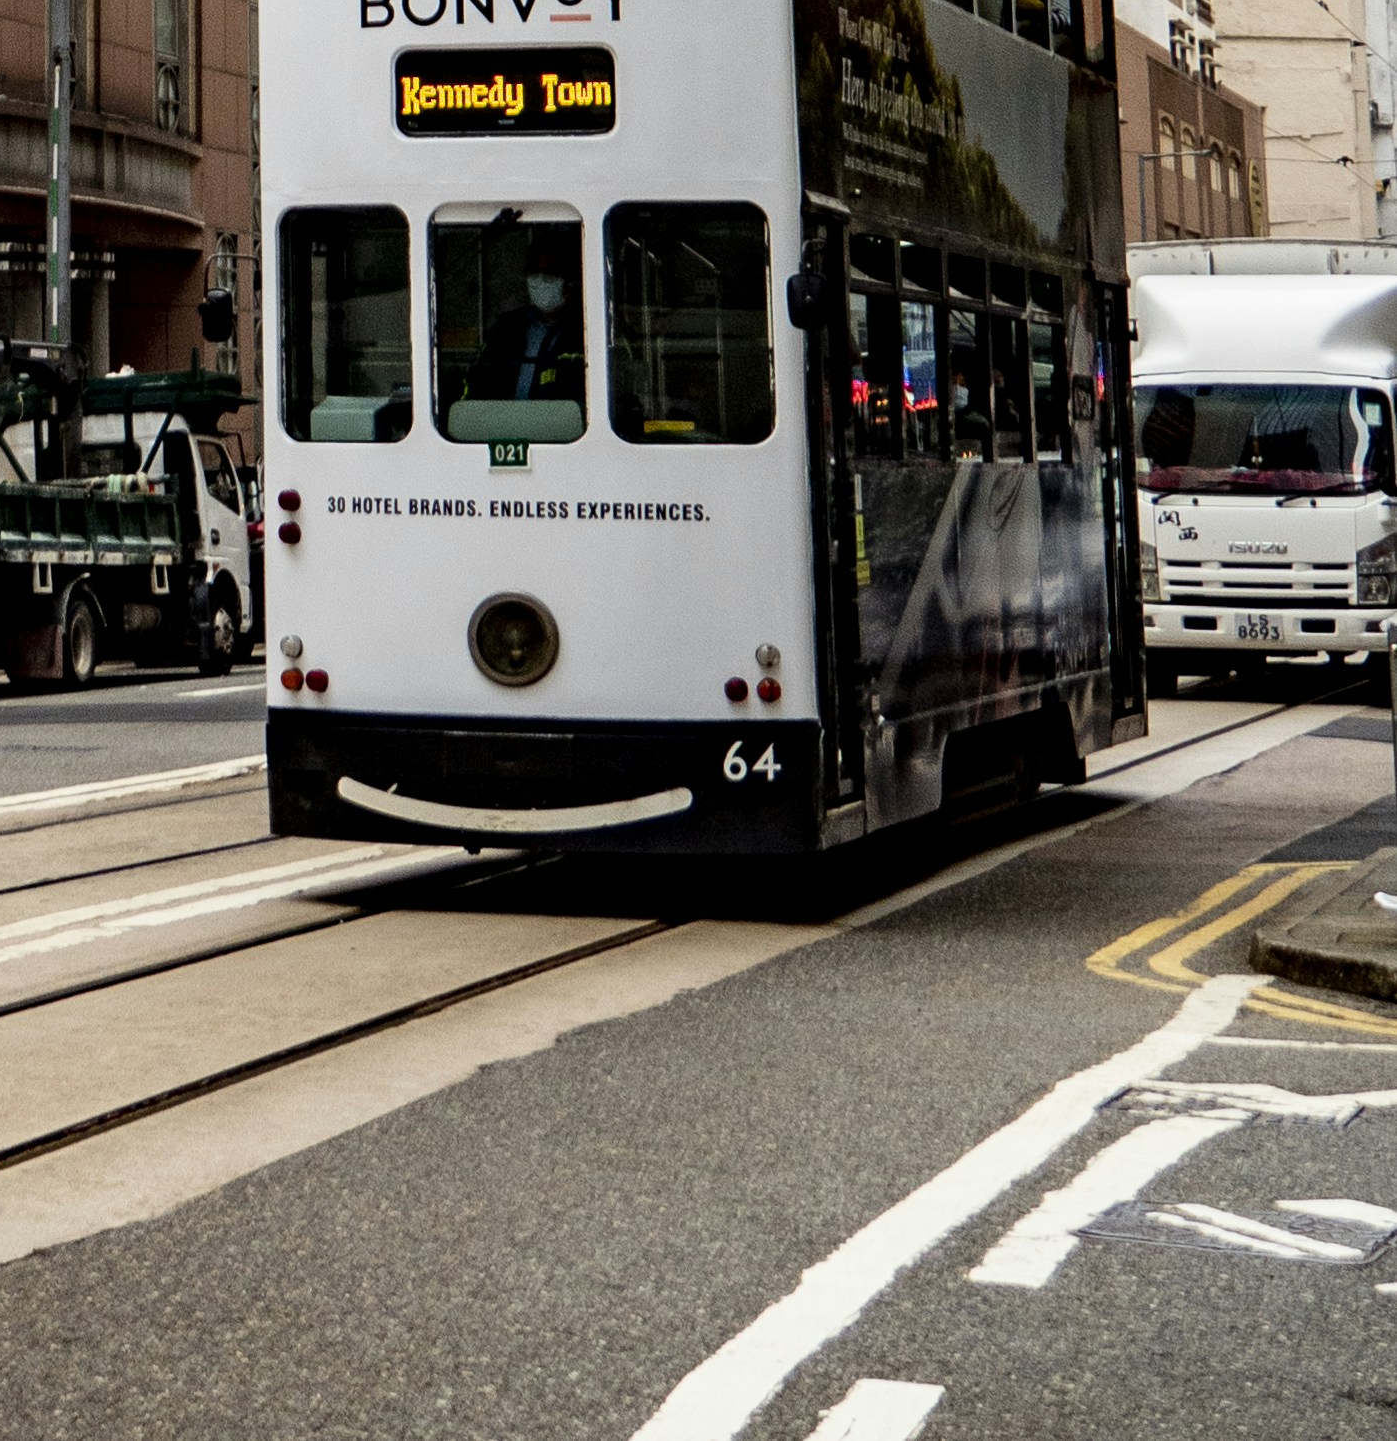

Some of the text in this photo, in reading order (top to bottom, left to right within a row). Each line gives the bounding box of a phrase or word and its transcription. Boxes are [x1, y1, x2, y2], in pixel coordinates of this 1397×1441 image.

[401, 73, 612, 116] Kennedy Town
[495, 443, 525, 462] 021
[328, 496, 711, 521] 30 HOTEL BRANDS. ENDLESS EXPERIENCES.
[1227, 540, 1289, 554] ISUZU
[1247, 614, 1269, 626] LS
[1238, 623, 1280, 640] 8693
[723, 740, 782, 782] 64
